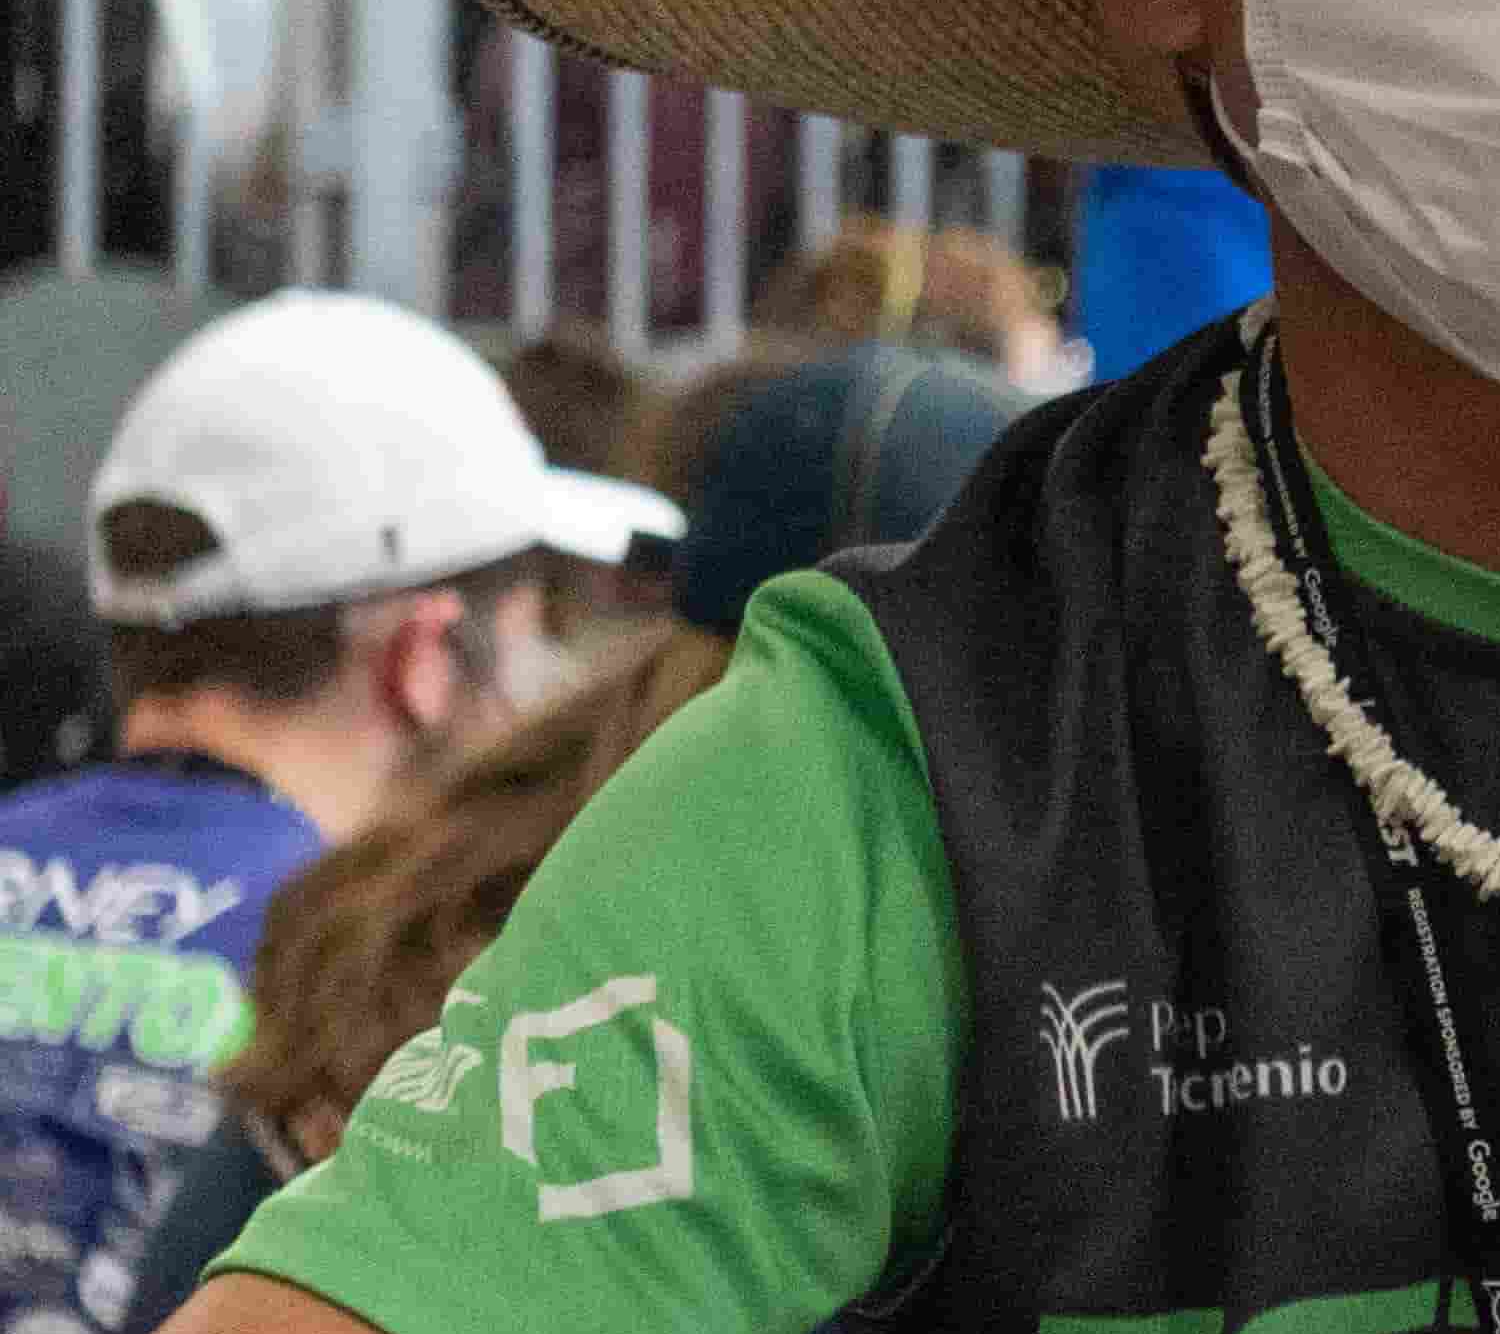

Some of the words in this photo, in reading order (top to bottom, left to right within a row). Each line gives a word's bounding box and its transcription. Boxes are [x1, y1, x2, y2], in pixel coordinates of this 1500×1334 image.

[1305, 567, 1338, 647] Google
[1408, 887, 1448, 1004] REGISTRATION
[1437, 1007, 1471, 1105] SPONSORED
[1458, 1107, 1480, 1130] BY
